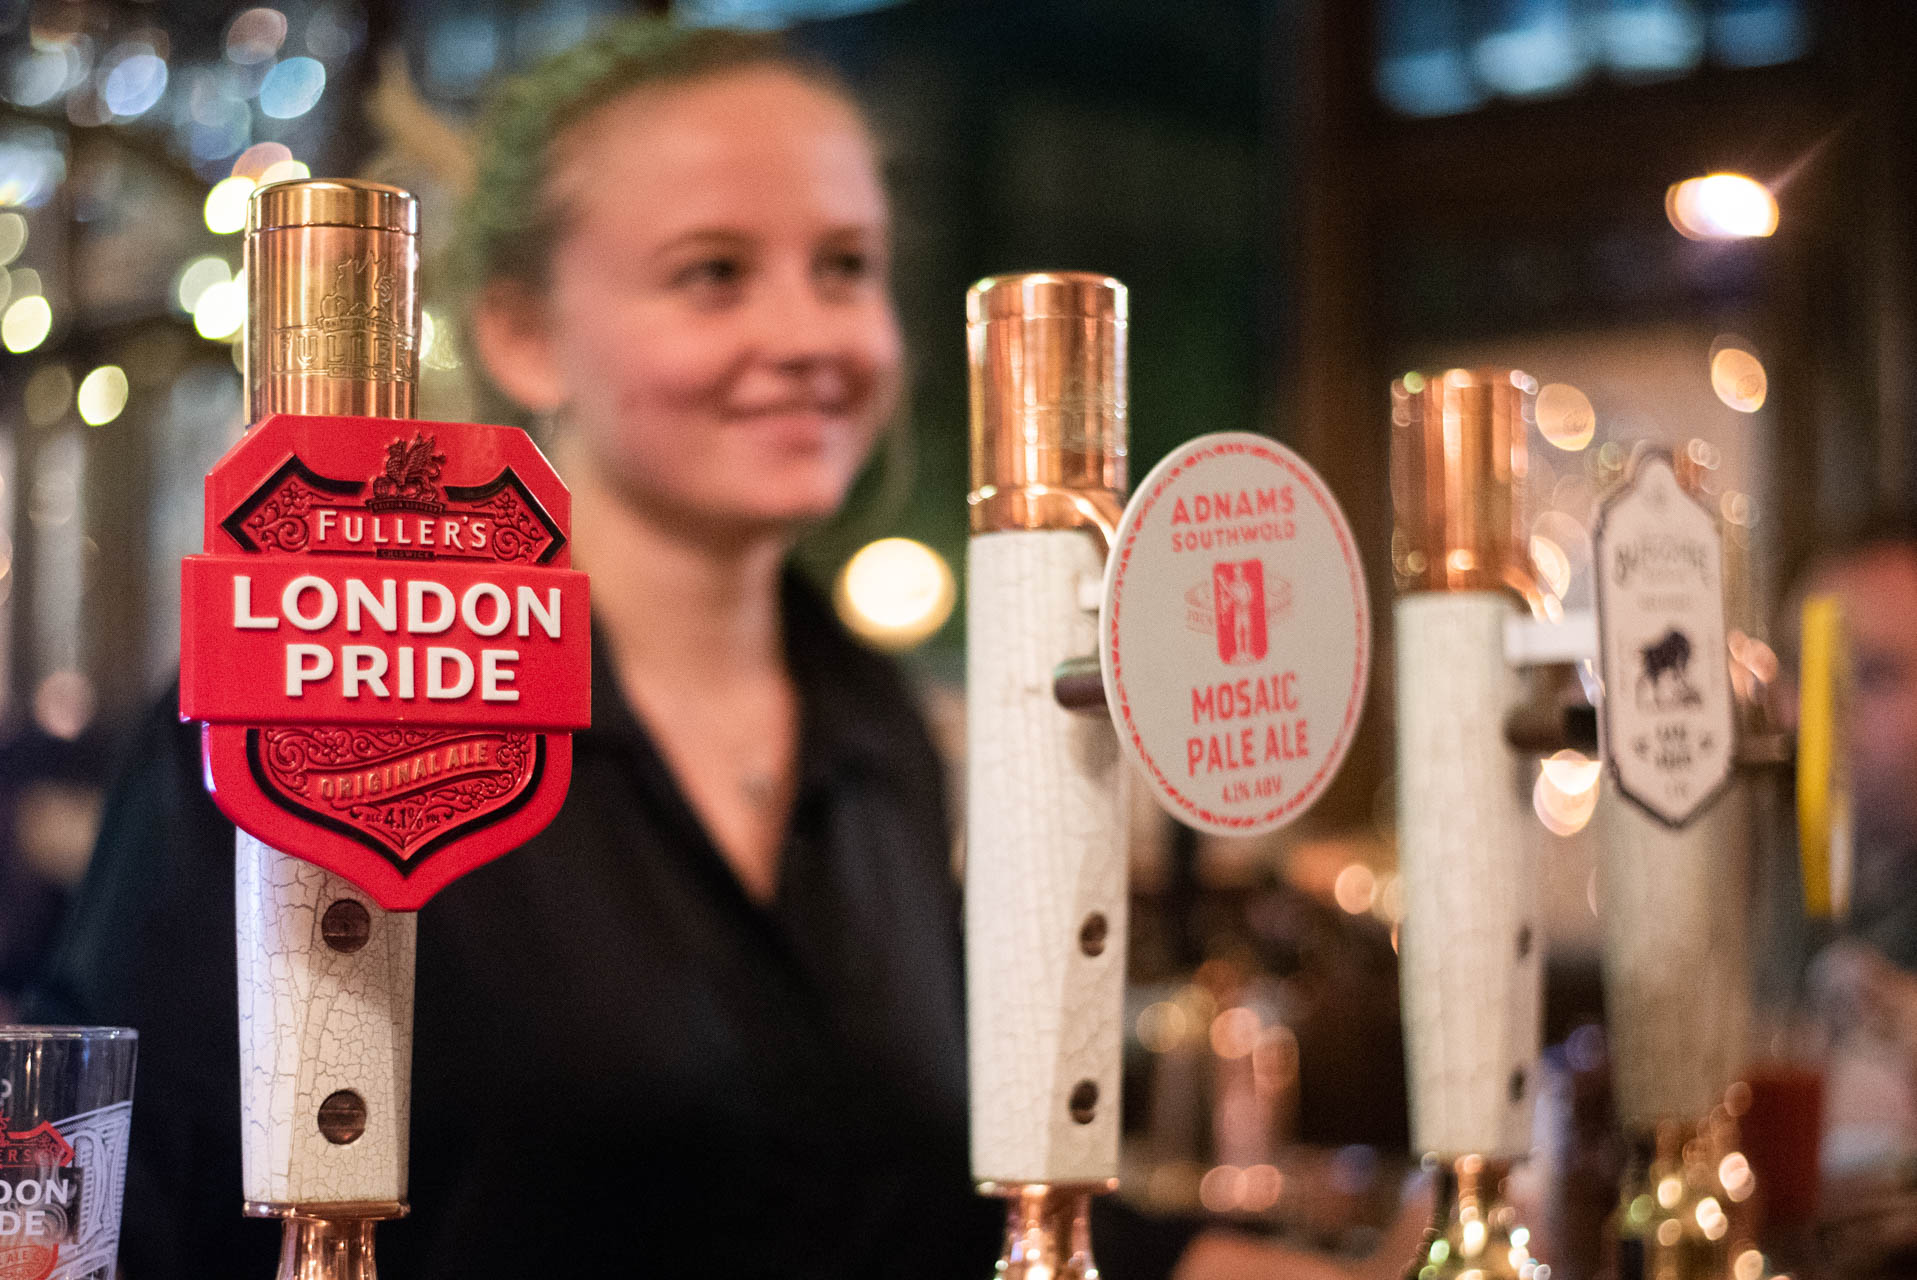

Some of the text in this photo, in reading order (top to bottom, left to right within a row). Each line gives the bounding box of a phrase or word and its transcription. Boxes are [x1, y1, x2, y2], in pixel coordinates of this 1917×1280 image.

[318, 510, 488, 550] FULLER'S
[1171, 485, 1295, 526] ADNAMS
[1171, 520, 1295, 553] SOUTHWOLD
[232, 575, 562, 639] LONDON
[285, 643, 520, 701] PRIDE
[1191, 671, 1297, 725] MOSAIC
[320, 743, 488, 799] ORIGINAL ALE
[1186, 719, 1309, 777] PALE ALE
[384, 807, 424, 830] 4.1%
